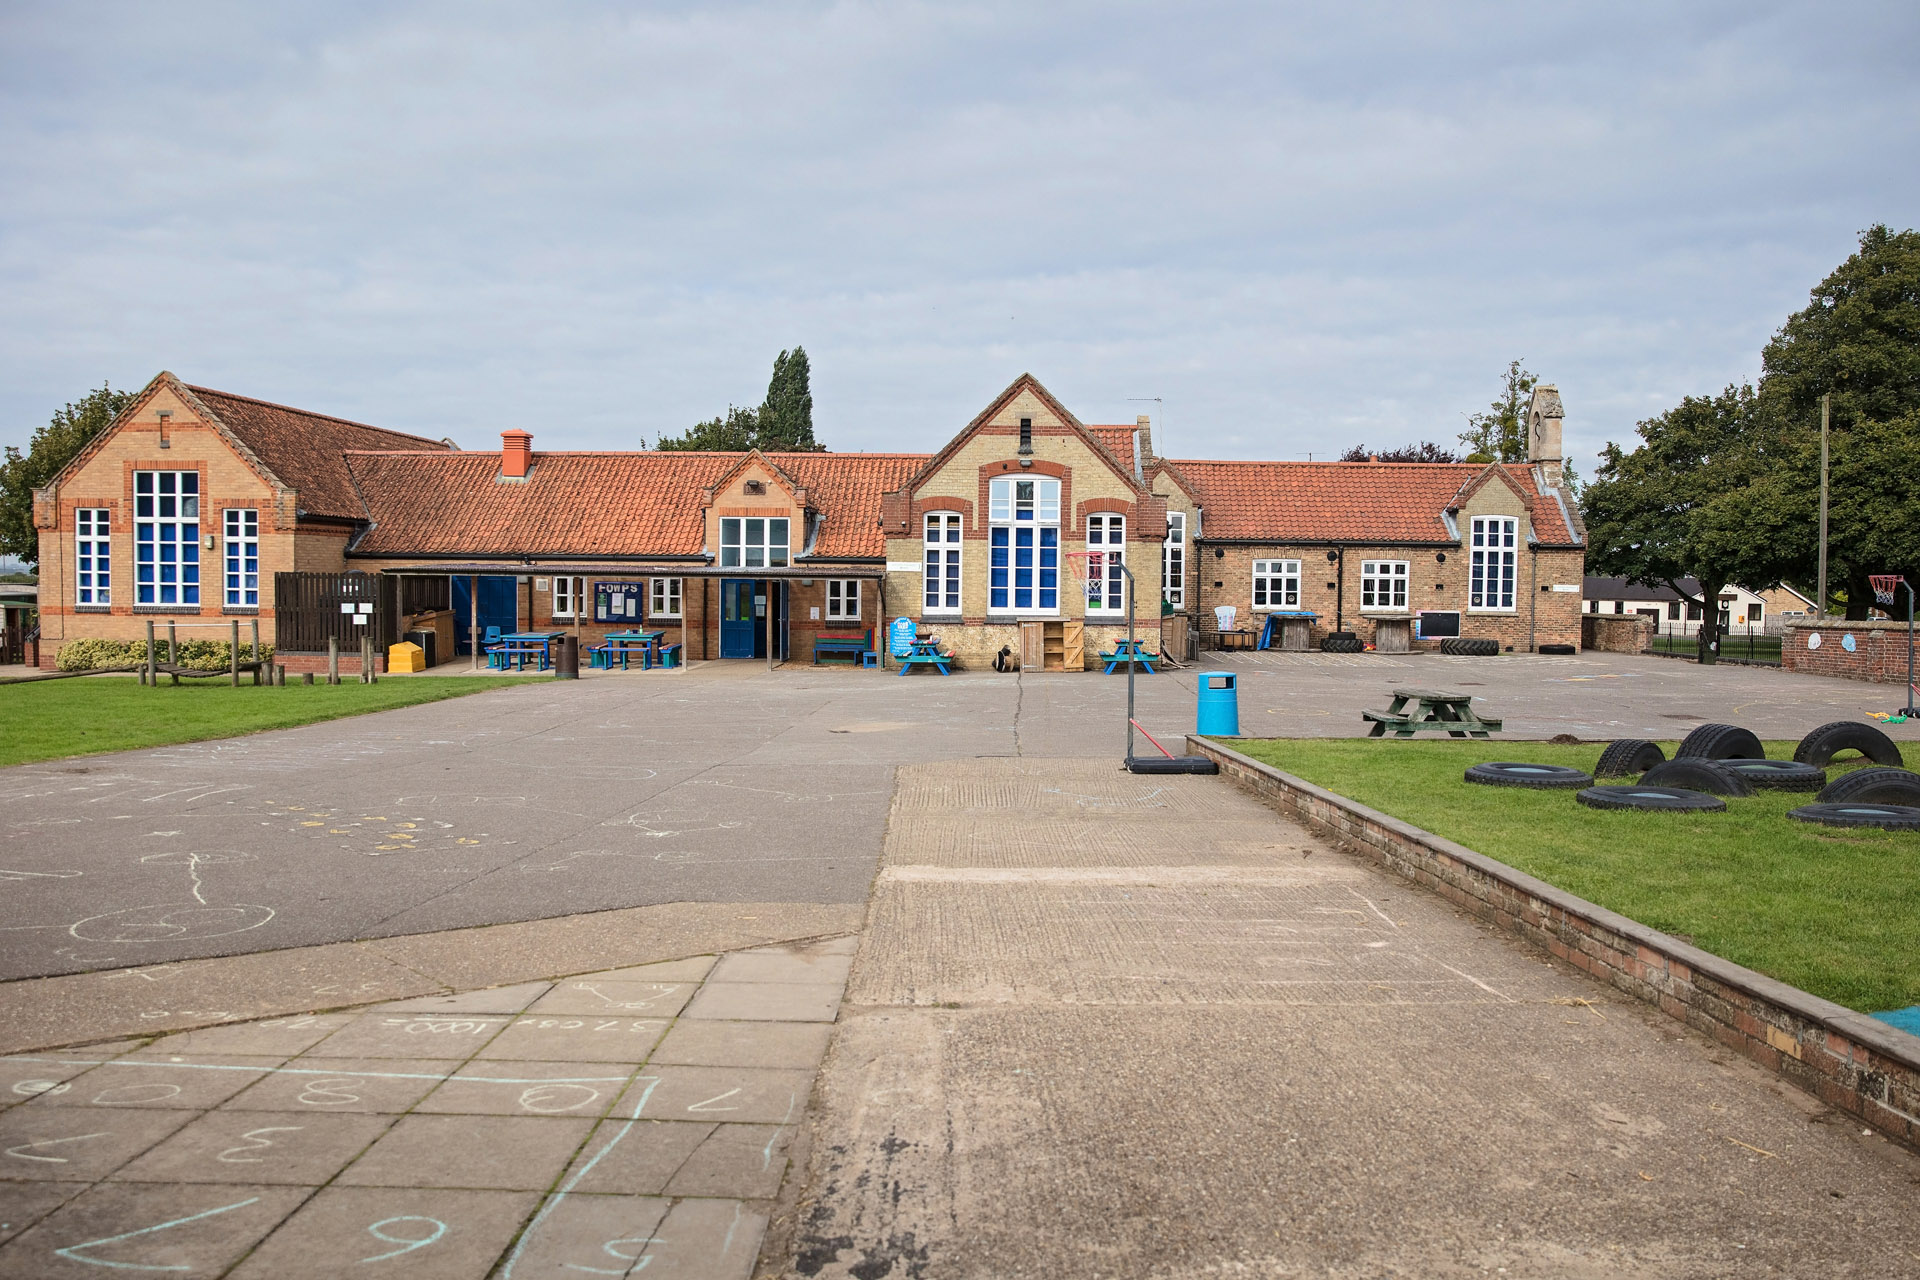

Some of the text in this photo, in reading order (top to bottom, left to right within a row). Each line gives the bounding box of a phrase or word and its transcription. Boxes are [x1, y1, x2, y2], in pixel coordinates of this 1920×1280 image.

[298, 1078, 366, 1105] 8
[216, 1126, 304, 1163] 3
[54, 1196, 668, 1276] 5 6 7
